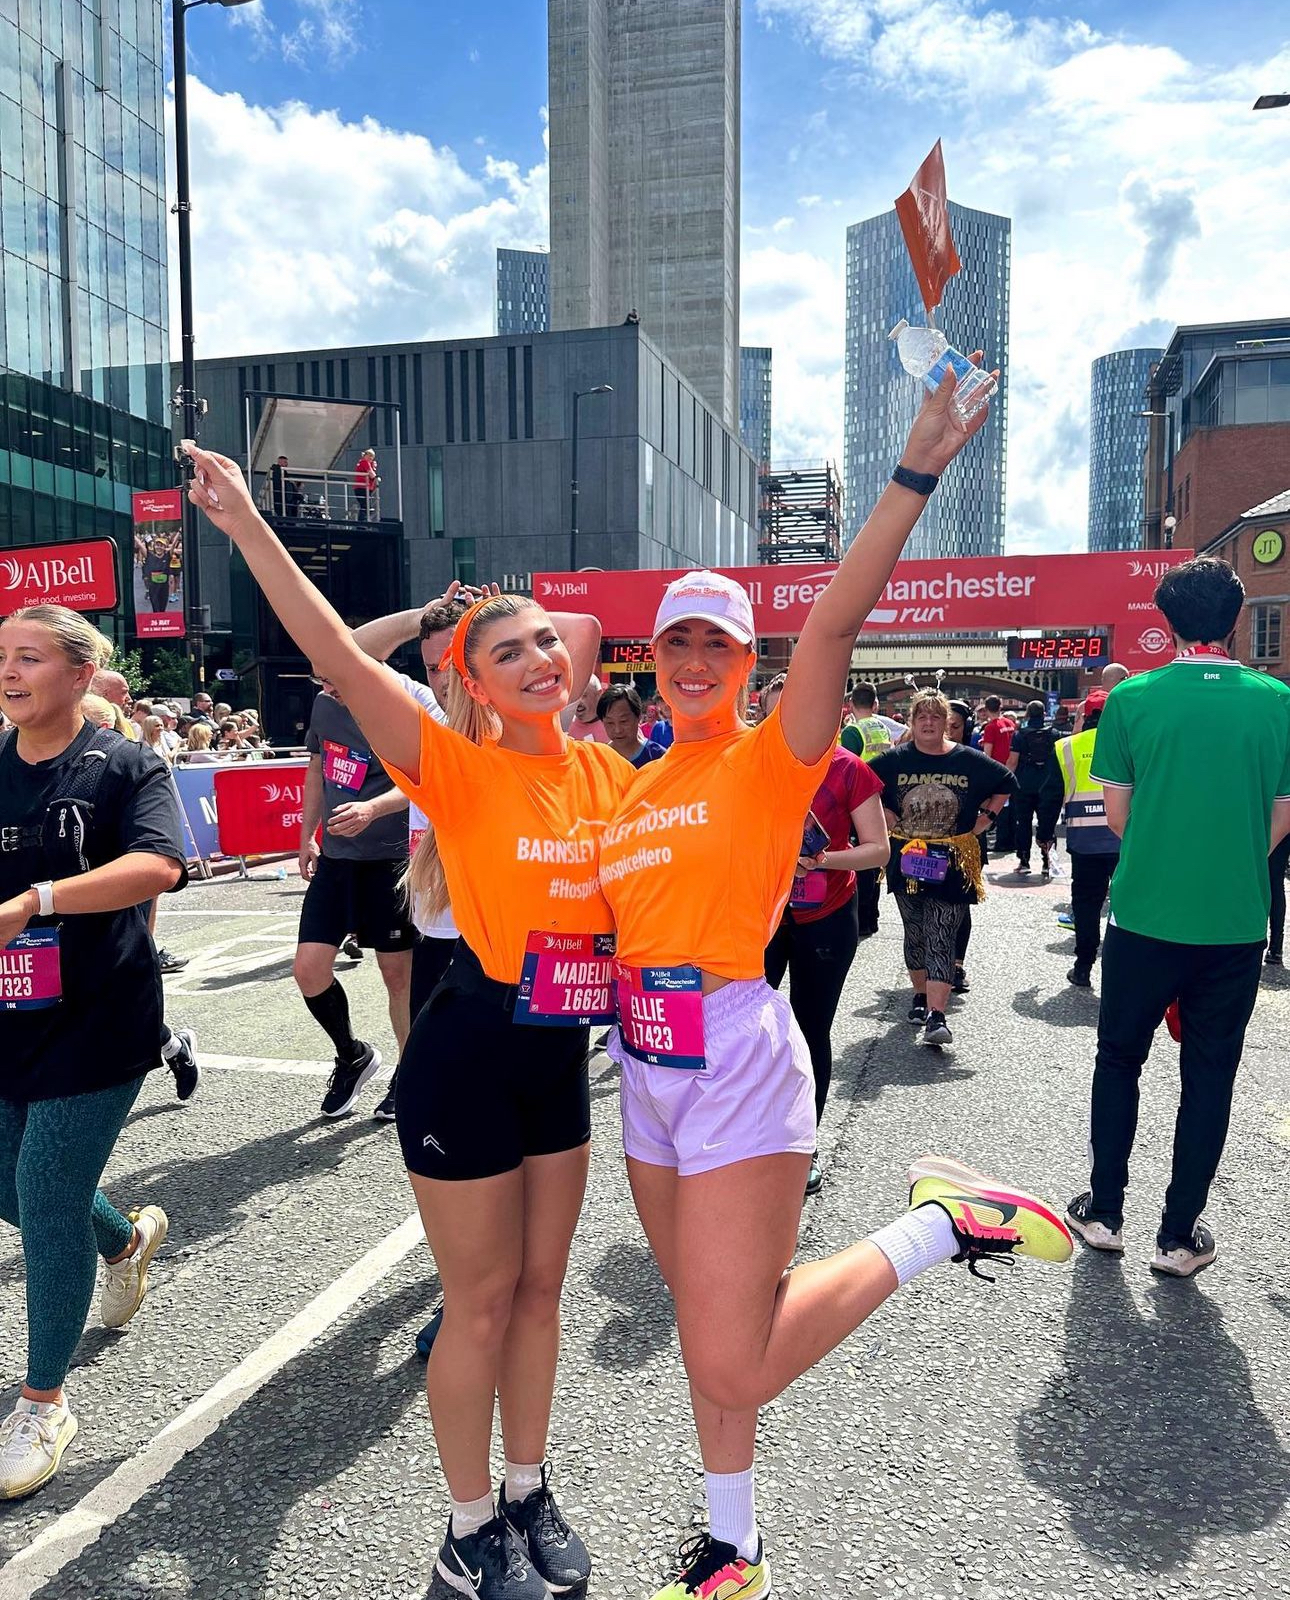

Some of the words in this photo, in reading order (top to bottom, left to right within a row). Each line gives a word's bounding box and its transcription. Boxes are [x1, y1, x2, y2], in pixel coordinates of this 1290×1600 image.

[1258, 540, 1276, 555] JT
[503, 573, 532, 590] Hil
[24, 597, 40, 606] Feel
[41, 595, 62, 605] good,
[773, 584, 828, 610] grea
[613, 645, 654, 663] 14:22
[1021, 638, 1101, 659] 14:22:28
[626, 663, 643, 672] ELITE
[1033, 659, 1054, 669] ELITE
[1054, 658, 1084, 668] WOMEN
[1203, 672, 1221, 680] ÉIRE
[332, 757, 358, 775] GARETH
[897, 773, 969, 788] DANCING
[1085, 804, 1104, 814] TEAM
[283, 812, 304, 828] gre
[600, 822, 639, 849] SLEY
[636, 802, 709, 835] HOSPICE
[517, 837, 594, 864] BARNSLEY
[599, 846, 673, 886] HospiceHero
[549, 877, 600, 901] #Hospice
[552, 961, 613, 984] MADELIN
[561, 987, 608, 1012] 16620
[631, 994, 666, 1023] ELLIE
[578, 1017, 591, 1025] 10K
[631, 1020, 674, 1051] 17423
